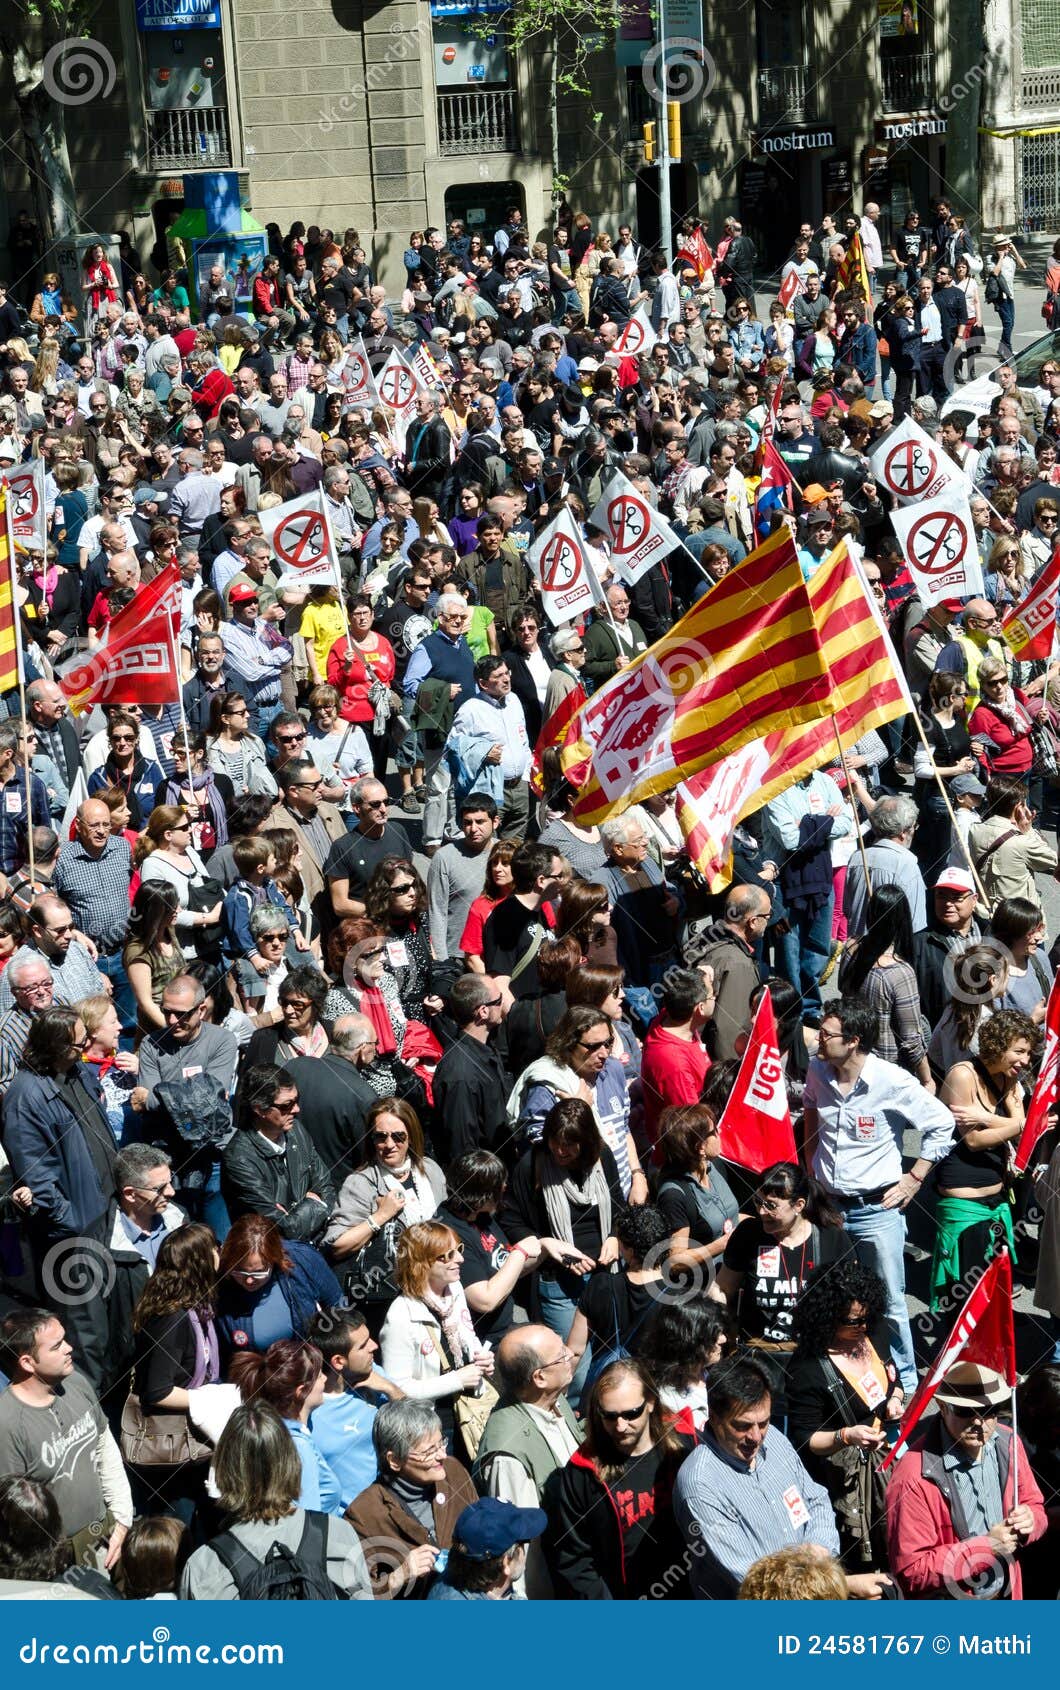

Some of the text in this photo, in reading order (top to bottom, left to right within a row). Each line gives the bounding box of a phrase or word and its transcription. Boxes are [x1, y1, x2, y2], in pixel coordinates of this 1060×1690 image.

[145, 0, 212, 15] FREEDOM
[762, 131, 834, 153] nostrum
[752, 1043, 781, 1101] UGT
